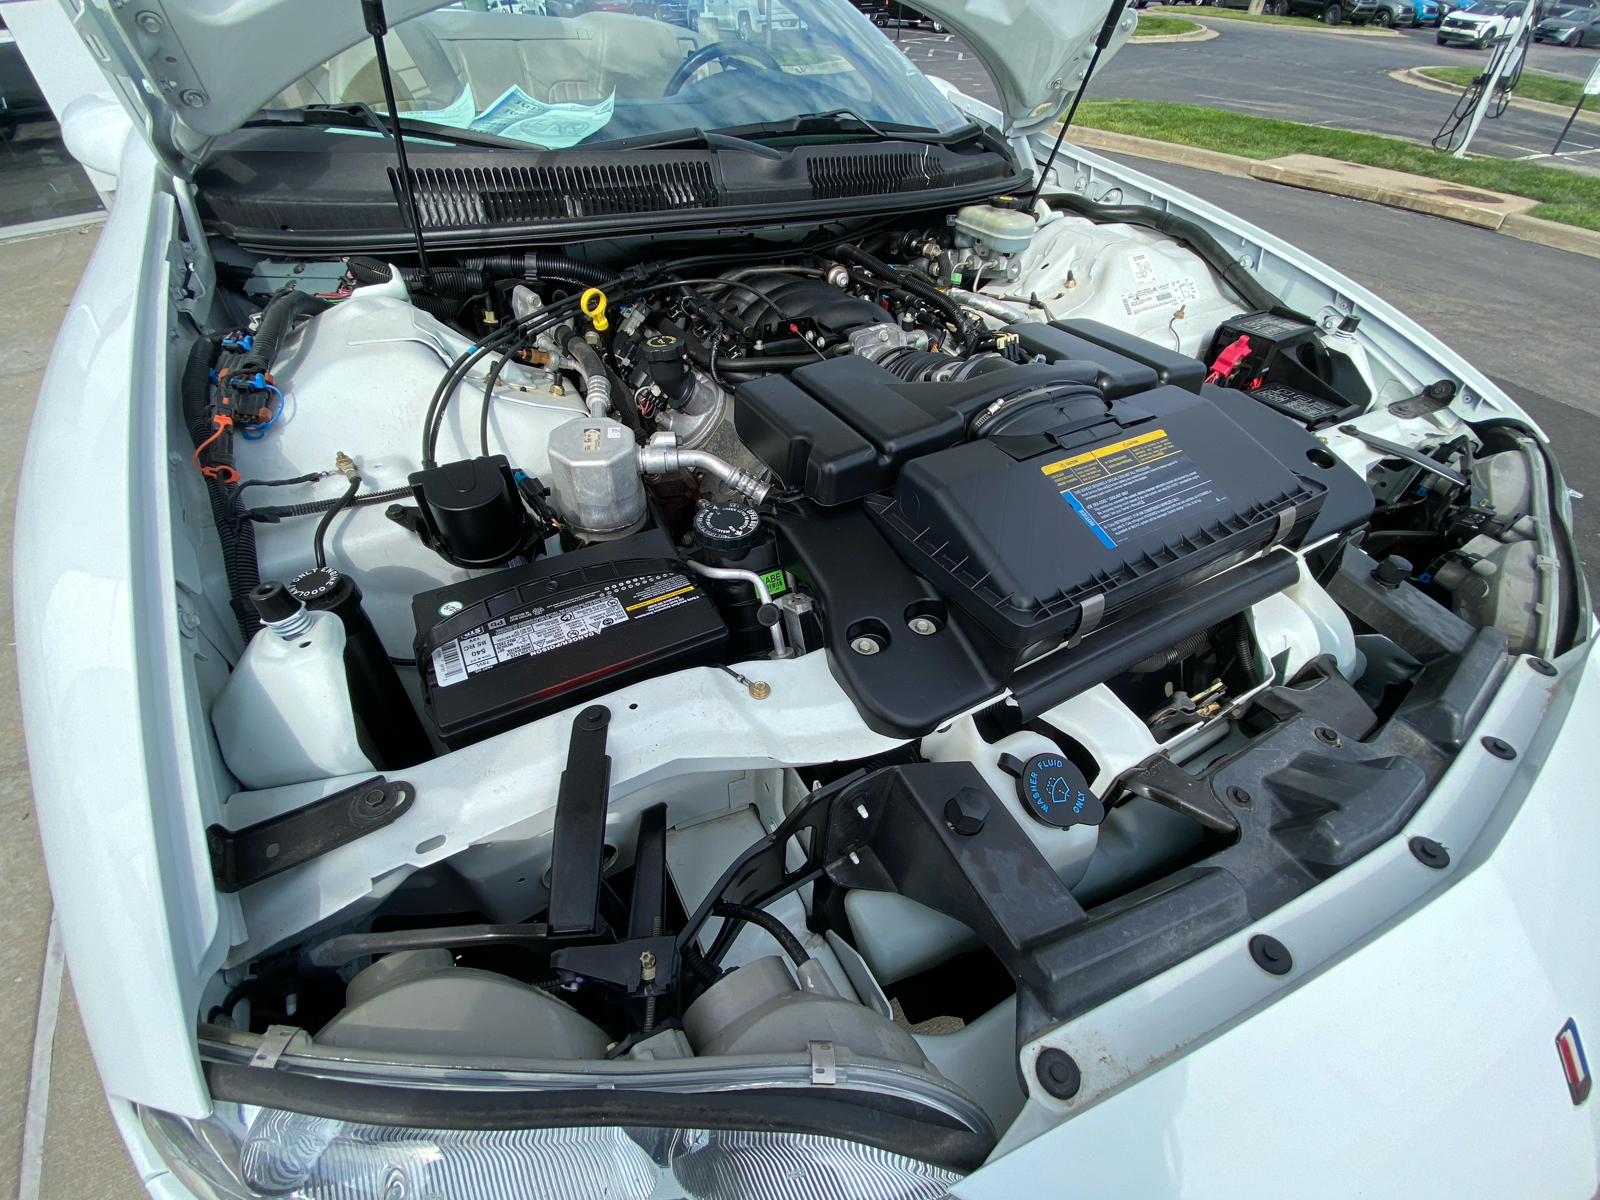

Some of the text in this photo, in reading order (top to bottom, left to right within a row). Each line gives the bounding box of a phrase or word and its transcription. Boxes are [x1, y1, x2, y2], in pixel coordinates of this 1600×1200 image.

[1078, 508, 1096, 527] NOTICE
[288, 566, 338, 597] ENGINE COOLANT ONLY
[765, 572, 781, 584] ABE
[490, 620, 503, 629] Pb
[462, 639, 486, 651] 85 RC
[530, 630, 600, 658] DANGER/POISON
[470, 647, 486, 657] 540
[1030, 759, 1085, 814] WASHER FLUID ONLY
